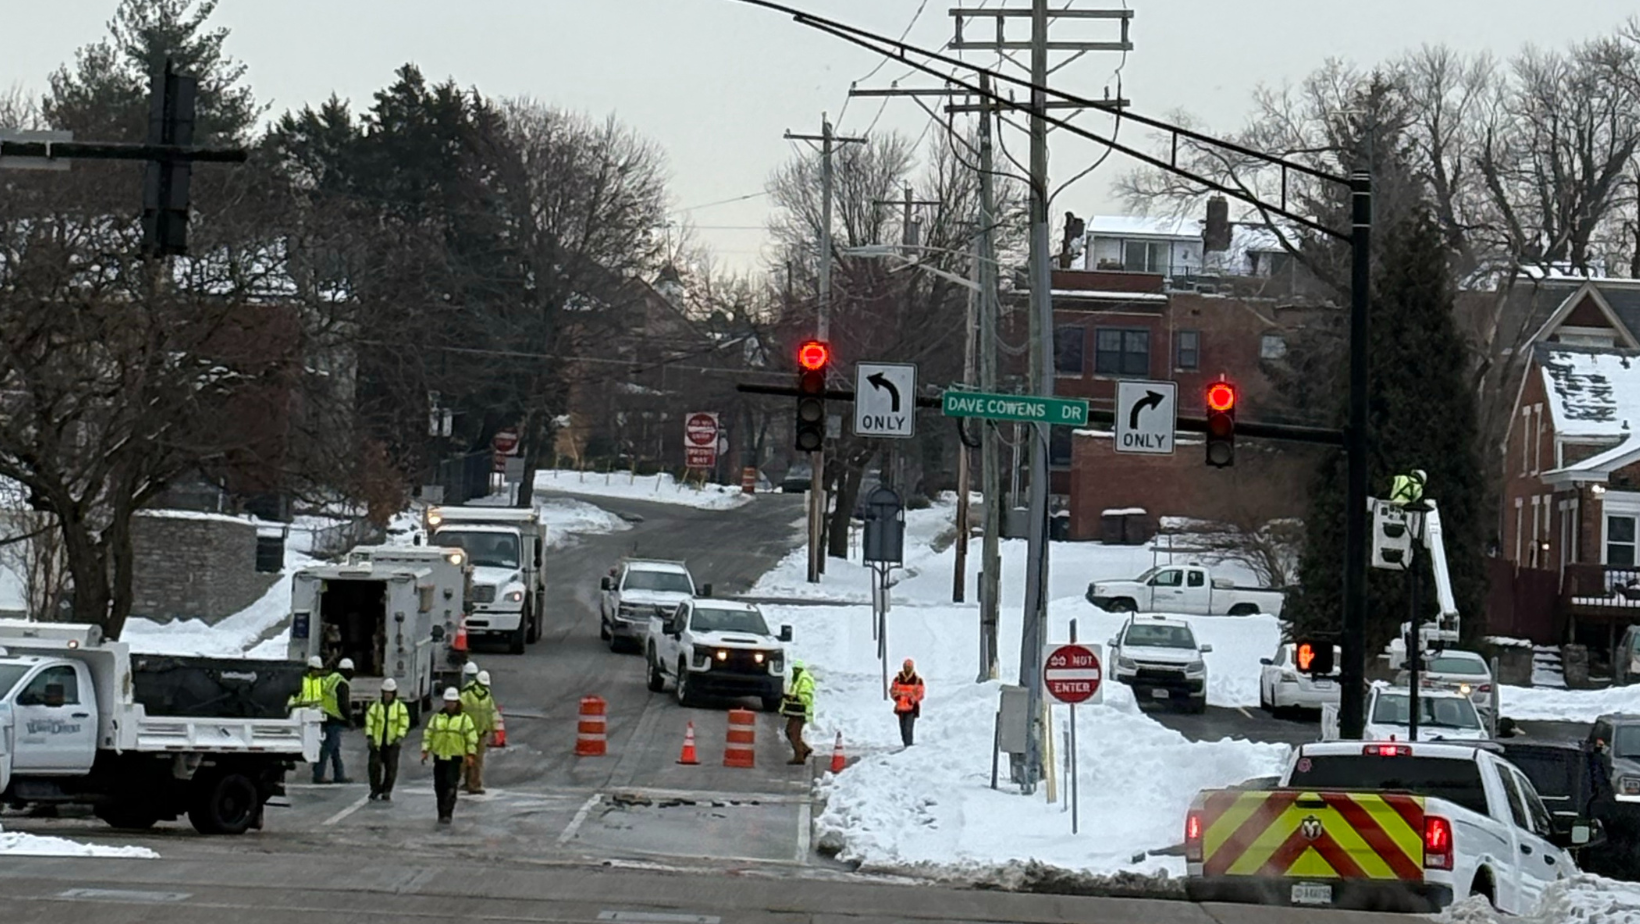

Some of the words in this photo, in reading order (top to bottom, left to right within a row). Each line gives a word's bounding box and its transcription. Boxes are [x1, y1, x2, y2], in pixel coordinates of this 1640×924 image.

[948, 396, 984, 413] DAVE
[987, 400, 1045, 417] COWENS
[1061, 405, 1082, 420] DR
[862, 414, 906, 430] ONLY
[1123, 432, 1166, 449] ONLY
[1050, 655, 1067, 666] DO
[1072, 655, 1092, 666] NOT
[1054, 682, 1091, 693] ENTER
